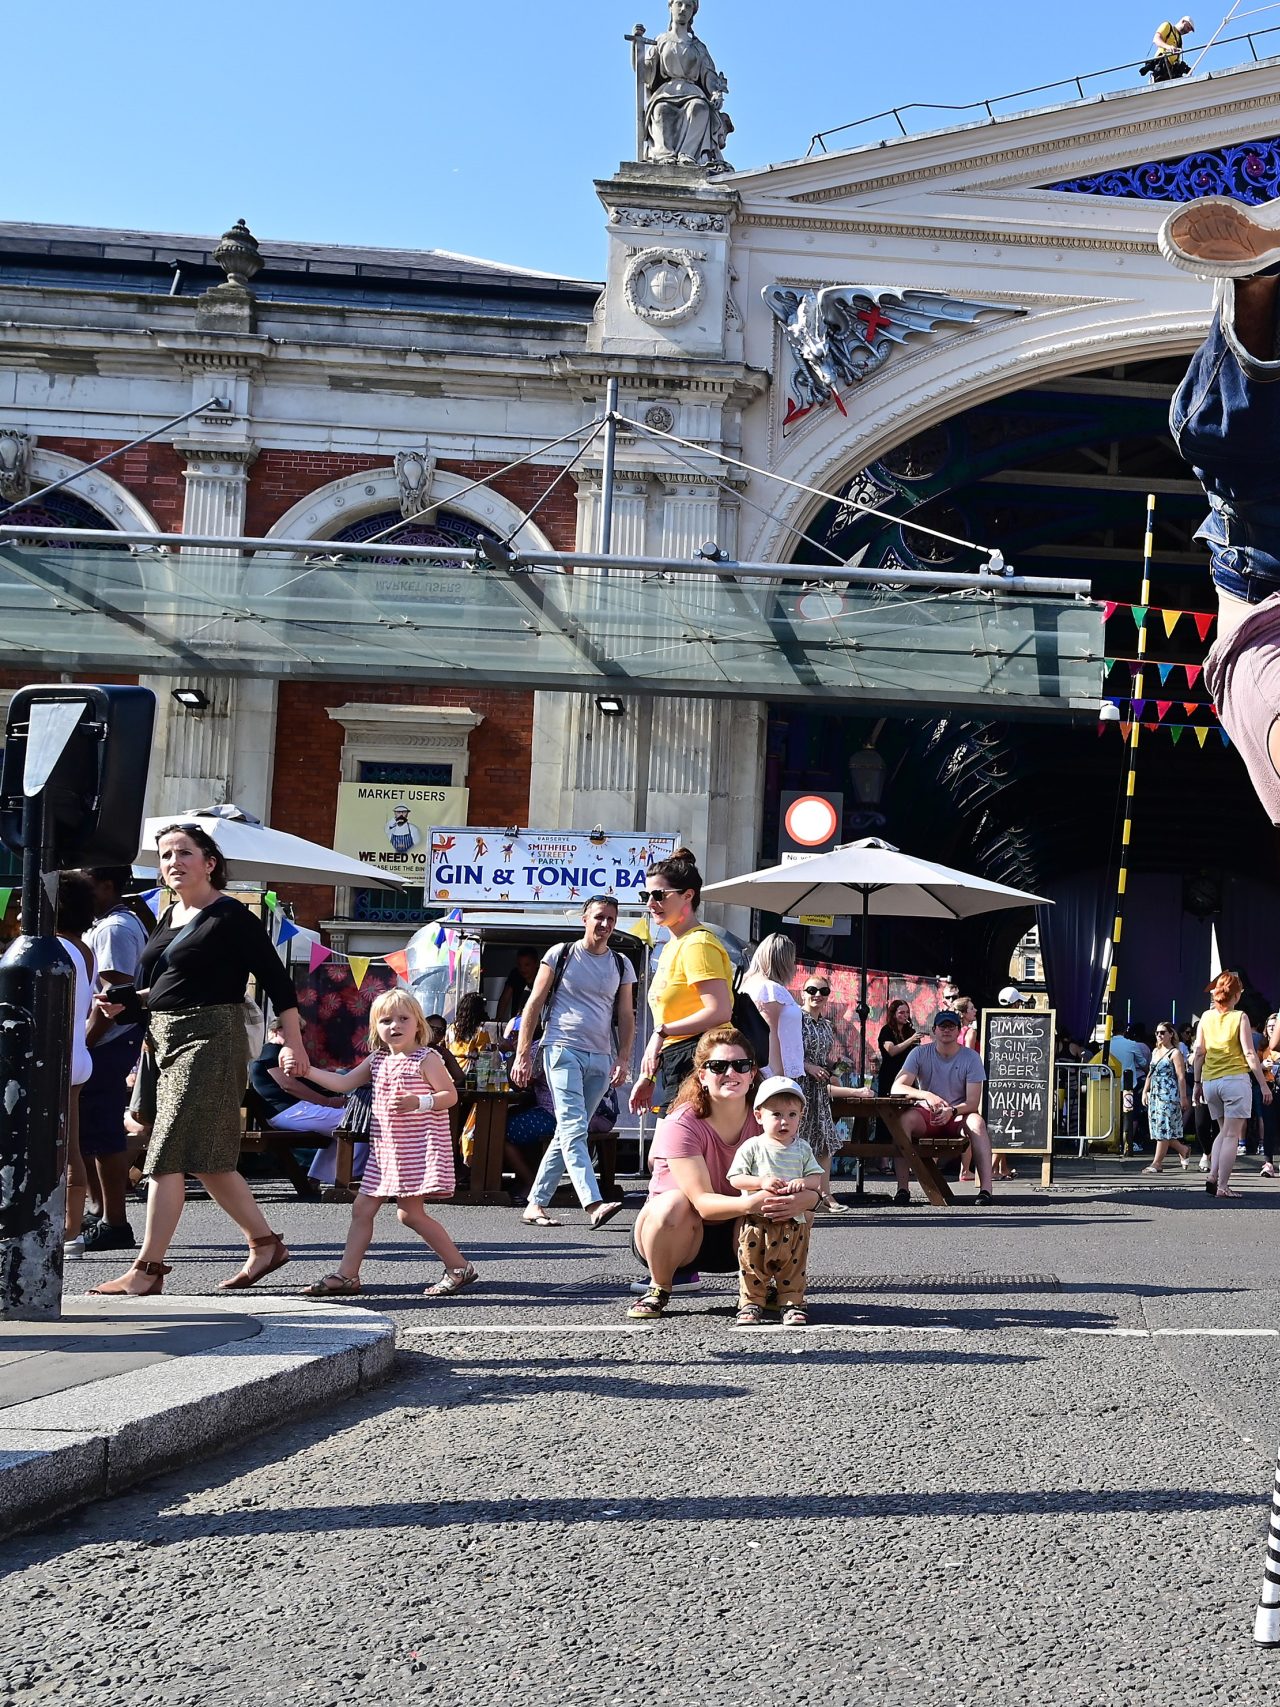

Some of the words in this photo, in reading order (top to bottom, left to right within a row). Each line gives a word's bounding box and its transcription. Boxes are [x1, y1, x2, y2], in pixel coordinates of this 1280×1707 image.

[358, 788, 405, 800] MARKET
[408, 790, 446, 802] USERS
[528, 844, 578, 852] SMITHFIELD
[358, 852, 376, 862] WE
[378, 852, 408, 863] NEED
[411, 854, 426, 864] YO
[435, 864, 483, 885] GIN
[492, 868, 515, 886] &
[522, 866, 607, 888] TONIC
[616, 868, 646, 888] BA
[990, 1020, 1034, 1035] PIMM'S
[1004, 1040, 1026, 1052] GIN
[989, 1052, 1038, 1062] DRAUGHT
[988, 1091, 1041, 1111] YAKIMA
